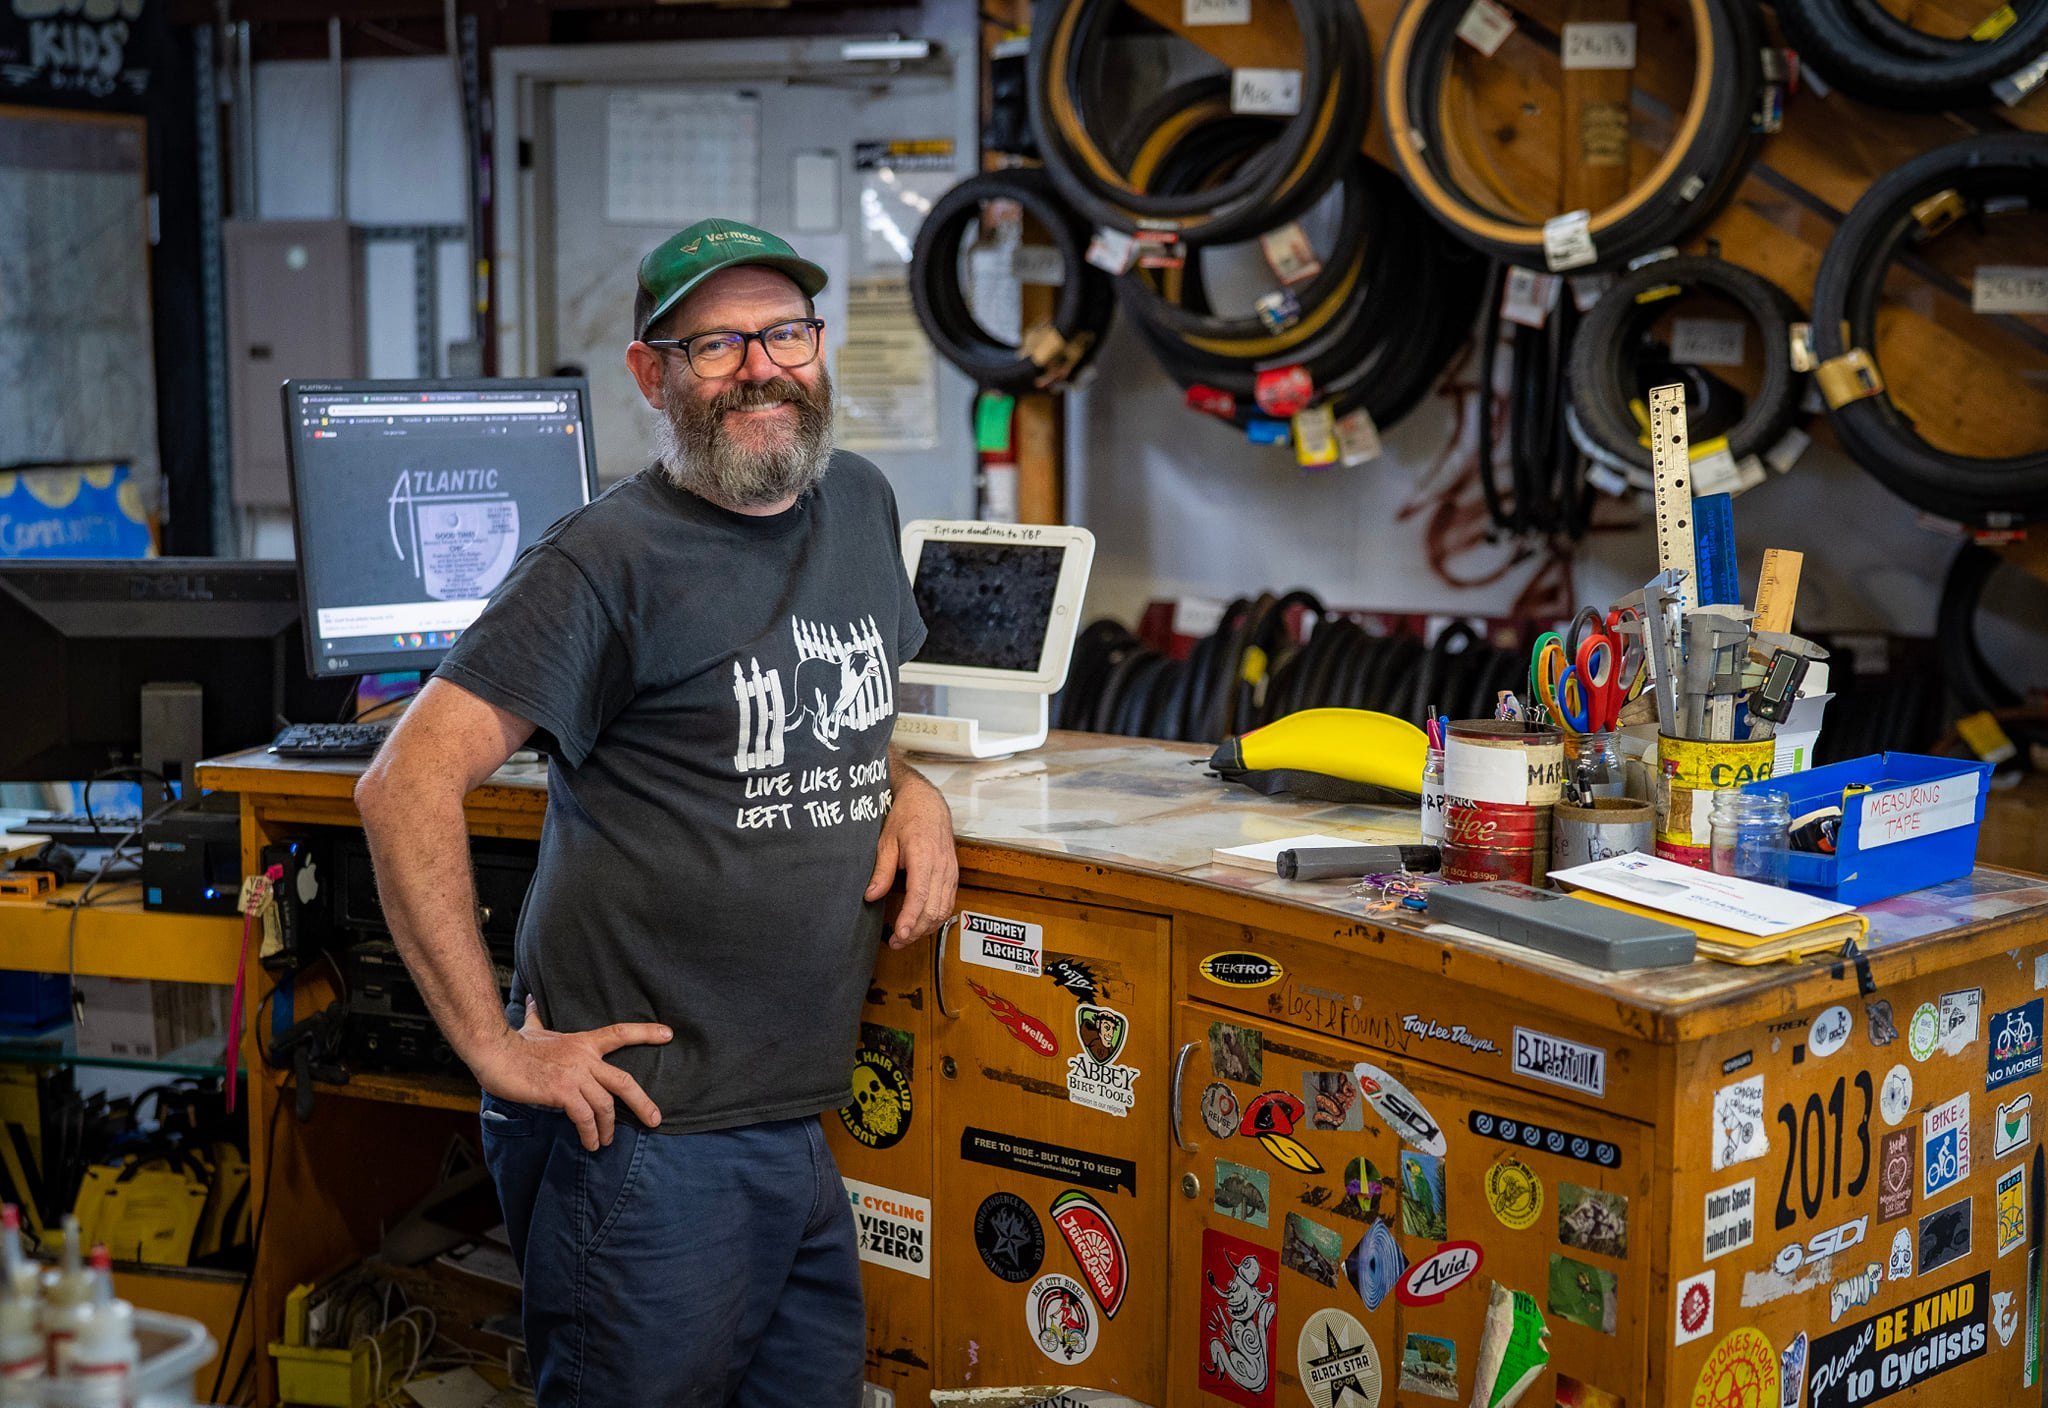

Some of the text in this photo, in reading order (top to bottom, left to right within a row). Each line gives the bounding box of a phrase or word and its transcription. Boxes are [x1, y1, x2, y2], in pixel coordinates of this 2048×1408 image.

[30, 21, 129, 77] KIDS
[705, 231, 762, 242] Vermeer
[744, 772, 793, 799] LIVE
[800, 766, 842, 793] LIKE
[736, 789, 893, 829] LEFT THE GATE OPE
[1870, 785, 1941, 817] MEASURING
[1884, 813, 1921, 840] TAPE
[971, 918, 1025, 939] STURMEY
[984, 942, 1031, 962] ARCHER
[1214, 963, 1268, 974] TEKTRO
[1021, 1021, 1054, 1052] wellgo
[1341, 1005, 1396, 1048] FOUND
[1403, 1015, 1498, 1052] Troy Lee Designs
[1767, 1017, 1810, 1034] TREK
[863, 1051, 912, 1111] HAIR CLUB
[1069, 1056, 1138, 1091] ABBEY
[1986, 1055, 2042, 1084] NO MORE!
[1071, 1092, 1093, 1105] Precision
[1207, 1110, 1232, 1130] REUSE
[1925, 1119, 1929, 1136] I
[1932, 1104, 1957, 1133] BIKE
[974, 1137, 997, 1150] FREE
[998, 1142, 1012, 1153] TO
[1013, 1145, 1034, 1158] RIDE
[1040, 1151, 1060, 1164] BUT
[1061, 1155, 1081, 1168] NOT
[1082, 1160, 1096, 1171] TO
[1097, 1164, 1122, 1177] KEEP
[1776, 1070, 1874, 1231] 2013
[1959, 1122, 1969, 1177] VOTE
[863, 1195, 925, 1222] CYCLING
[1707, 1186, 1751, 1221] Vulture Space
[859, 1213, 924, 1246] VISION
[976, 1195, 1020, 1234] INDEPENDENCE
[1020, 1202, 1043, 1246] BREWING
[1706, 1217, 1752, 1255] ruined my bike
[870, 1232, 924, 1264] ZERO
[1007, 1267, 1031, 1281] TEXAS
[1046, 1277, 1061, 1287] CITY
[1064, 1279, 1086, 1298] BIKES
[1412, 1250, 1469, 1294] Avid
[1875, 1307, 1909, 1352] BE
[1913, 1283, 1975, 1336] KIND
[1310, 1354, 1370, 1383] BLACK STAR
[1703, 1333, 1775, 1390] SPOKES HOME
[1810, 1324, 1875, 1408] Please
[1847, 1369, 1875, 1403] to
[1880, 1323, 1985, 1388] Cyclists
